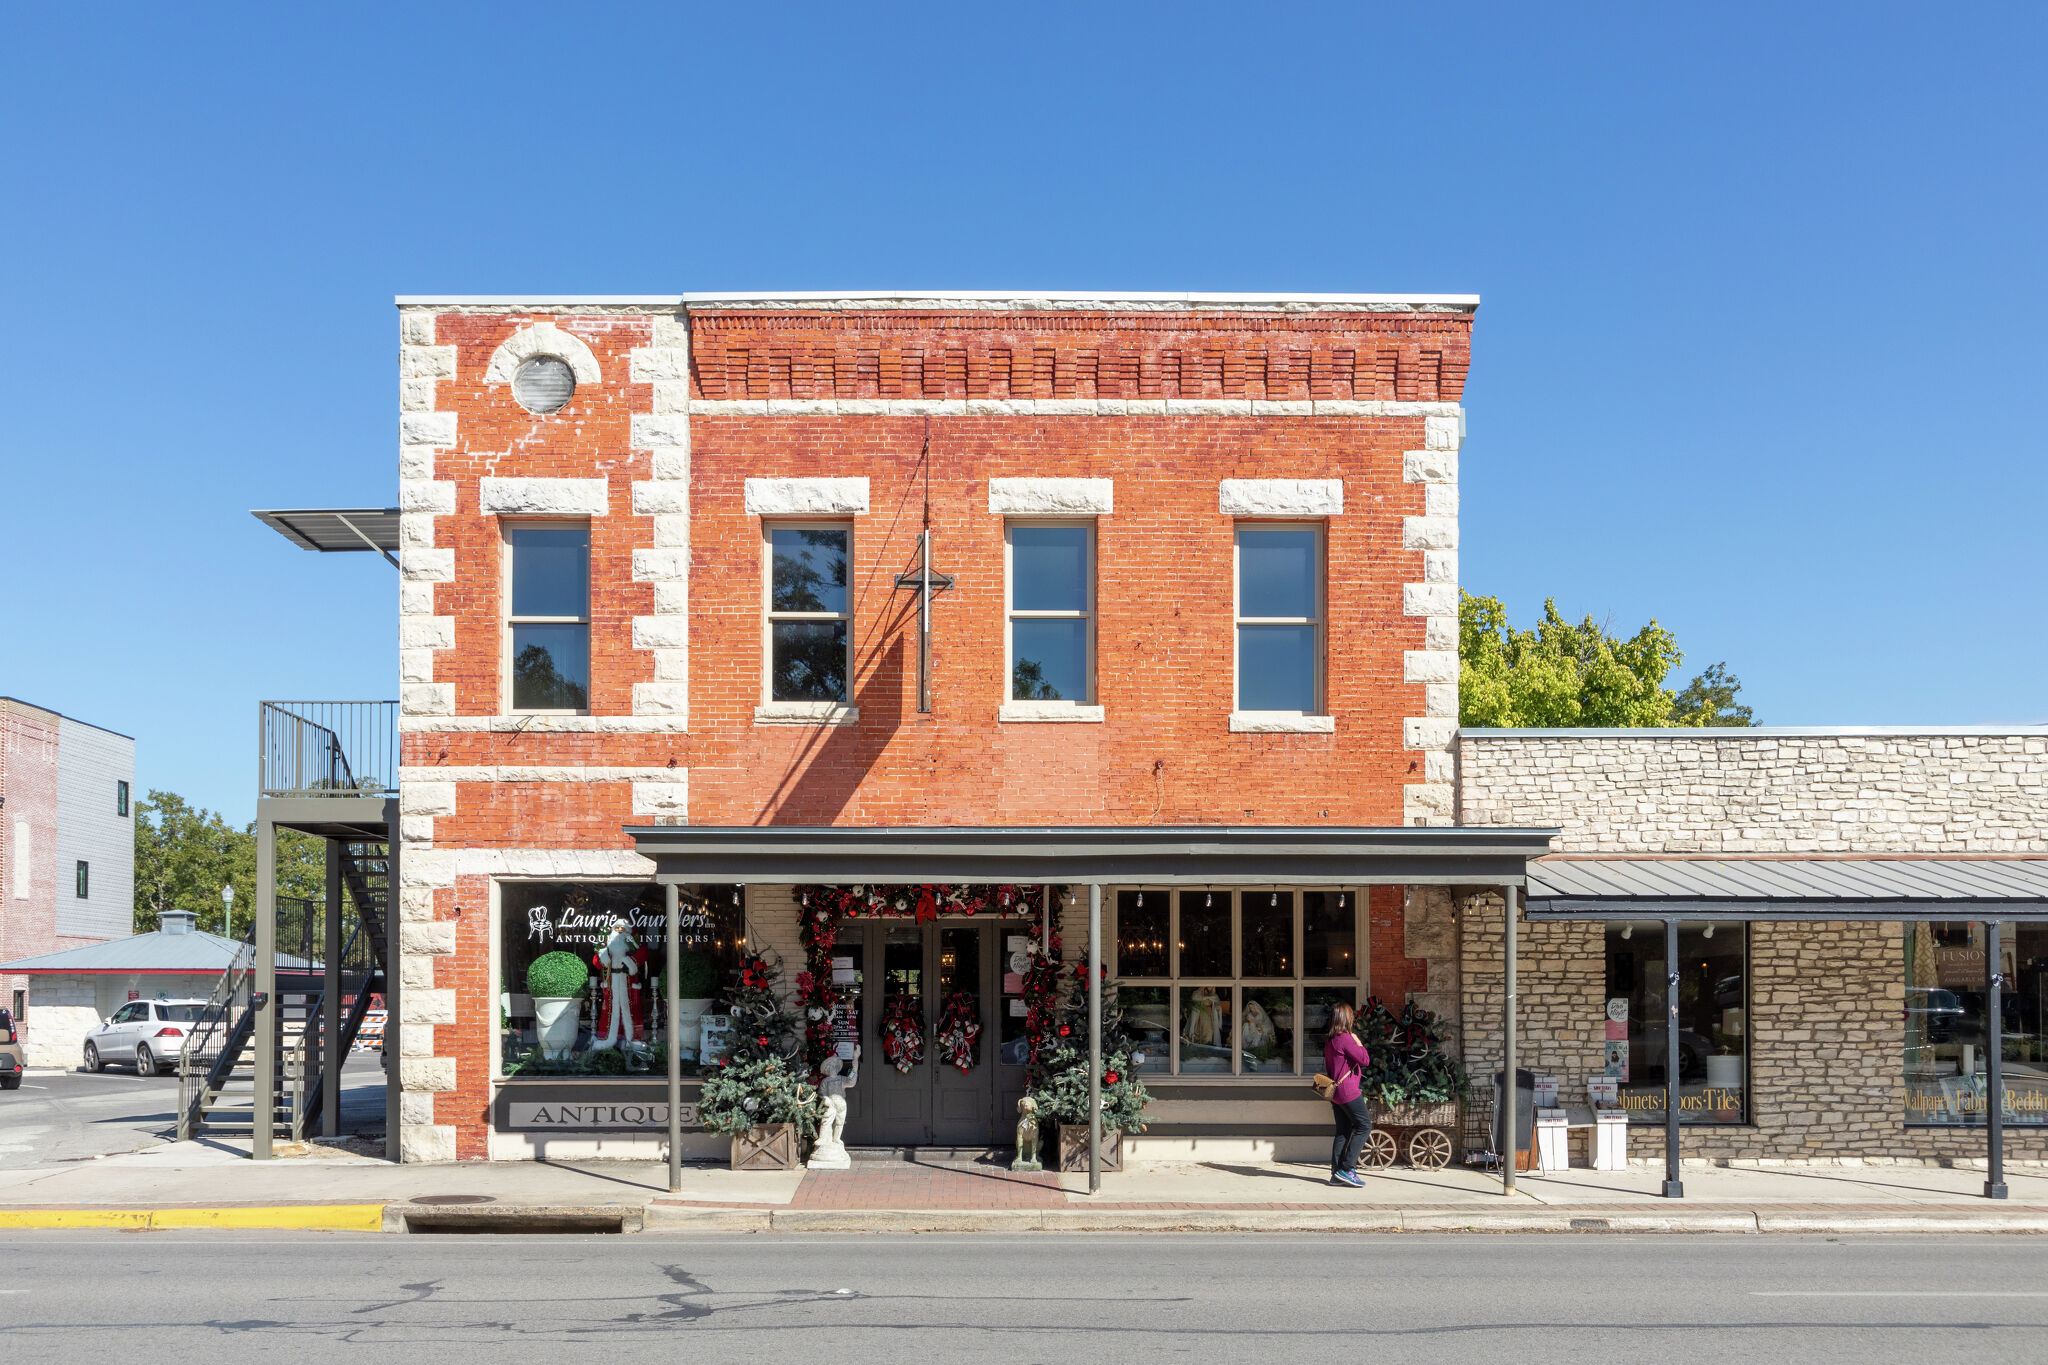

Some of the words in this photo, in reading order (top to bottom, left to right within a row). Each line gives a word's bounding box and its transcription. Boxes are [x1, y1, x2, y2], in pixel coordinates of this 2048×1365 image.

[558, 906, 617, 928] Laurie
[556, 934, 609, 944] ANTIQU
[639, 934, 709, 943] INTEIORS
[1616, 1088, 1658, 1110] abinets
[1703, 1088, 1740, 1110] Tiles
[1956, 1089, 1987, 1111] Fabri
[531, 1106, 696, 1125] ANTIQUE
